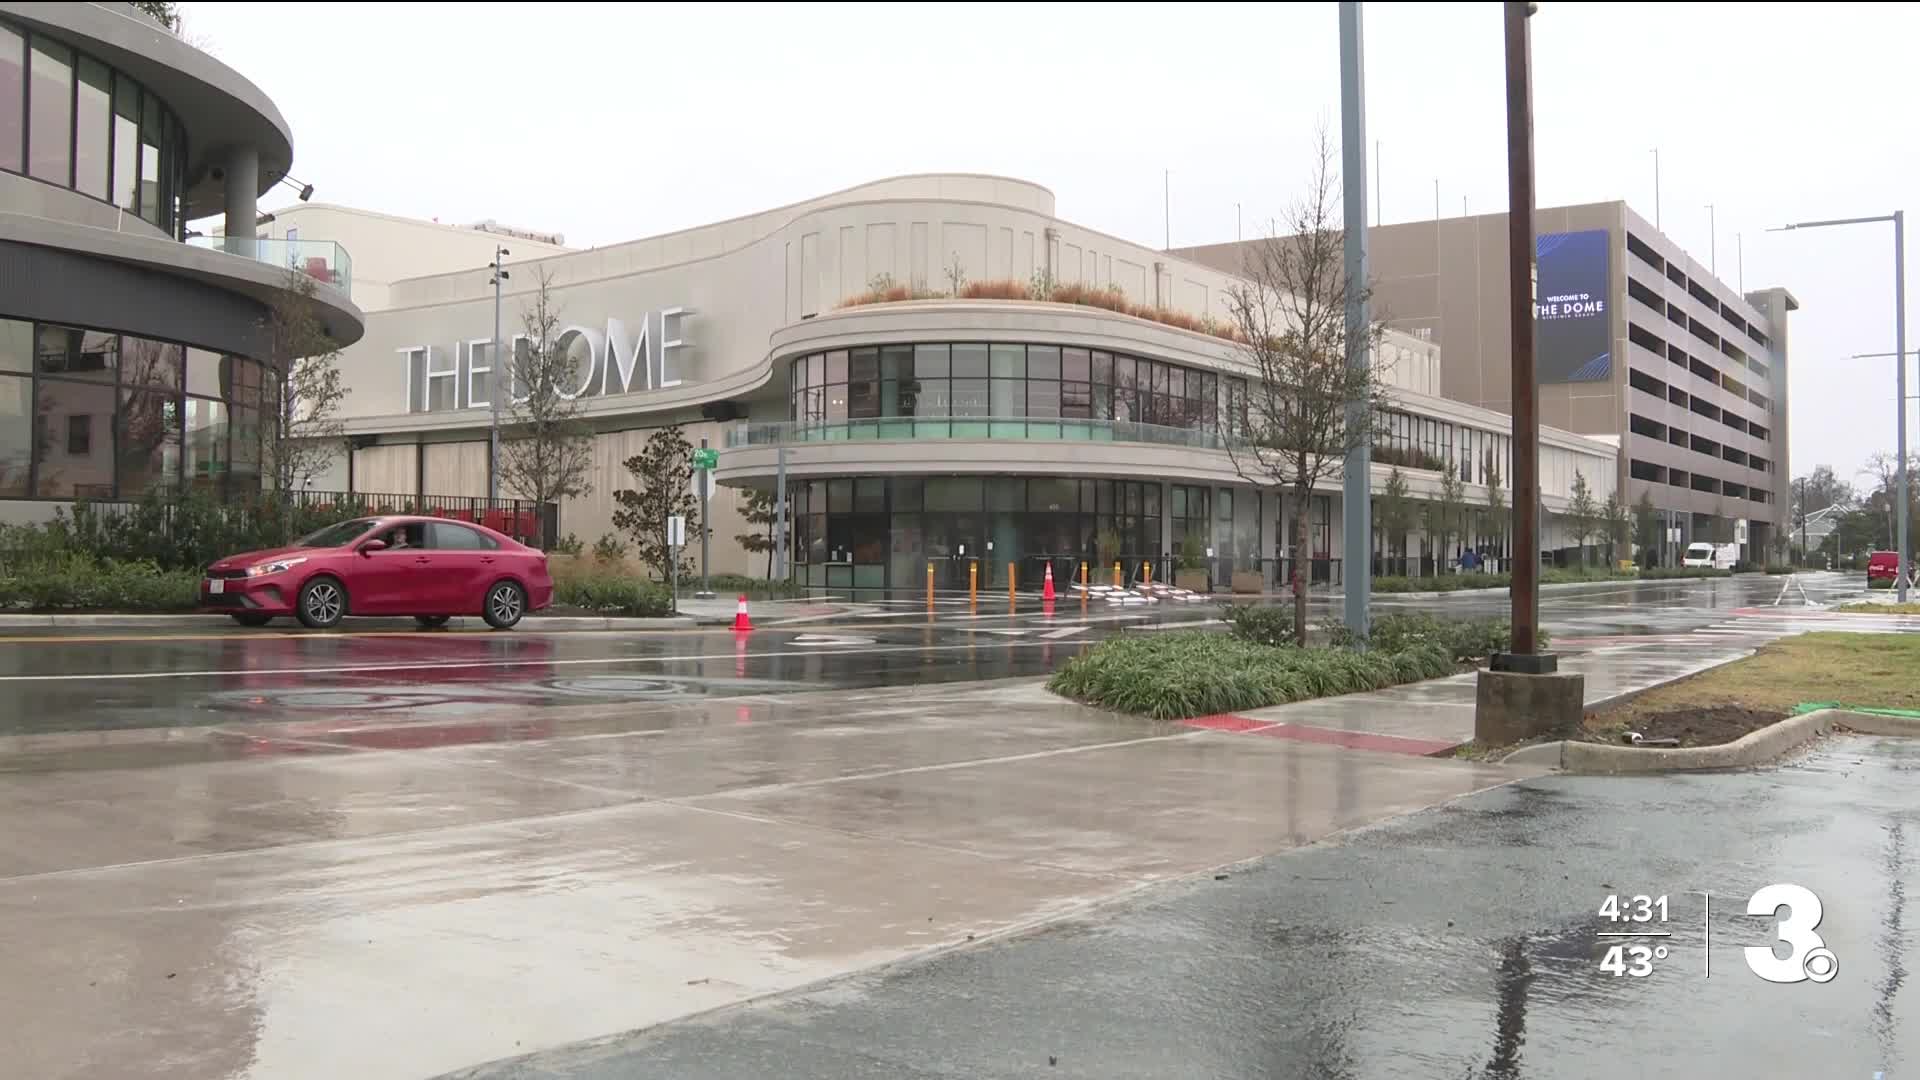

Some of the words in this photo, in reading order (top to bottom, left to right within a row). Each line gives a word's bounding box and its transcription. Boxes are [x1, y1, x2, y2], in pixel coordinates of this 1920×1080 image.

[1536, 304, 1557, 315] THE
[1564, 301, 1603, 314] DOME
[395, 337, 492, 414] THE
[511, 306, 694, 405] DOME
